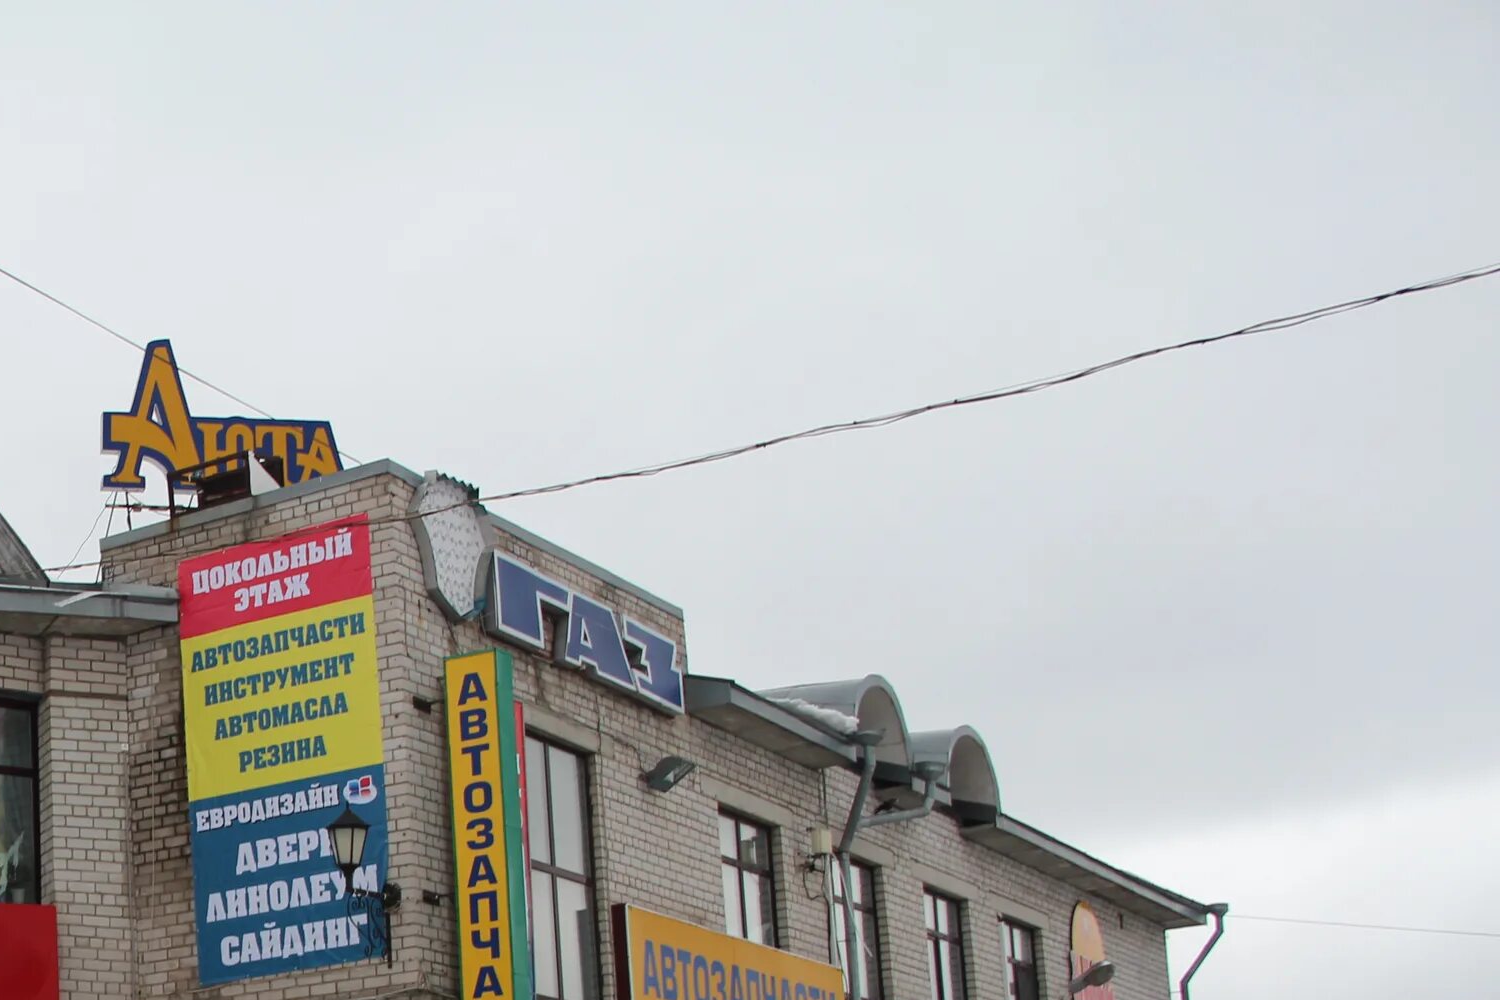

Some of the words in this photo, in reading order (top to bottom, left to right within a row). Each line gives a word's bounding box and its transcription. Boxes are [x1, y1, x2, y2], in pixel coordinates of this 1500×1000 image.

[191, 528, 353, 595] ЦОКОЛЬНЫЙ
[234, 573, 311, 612] ЭТАЖ
[191, 612, 366, 673] АВТОЗАПЧАСТИ
[493, 549, 685, 714] ГАЗ
[204, 652, 355, 706] ИНСТРУМЕНТ
[214, 691, 348, 740] АВТОМАСЛА
[239, 735, 327, 773] РЕЗИНА
[196, 782, 339, 833] ЕВРОДИЗАЙН
[206, 864, 378, 923] ЛИНОЛЕУМ
[221, 913, 368, 967] САЙДИНГ
